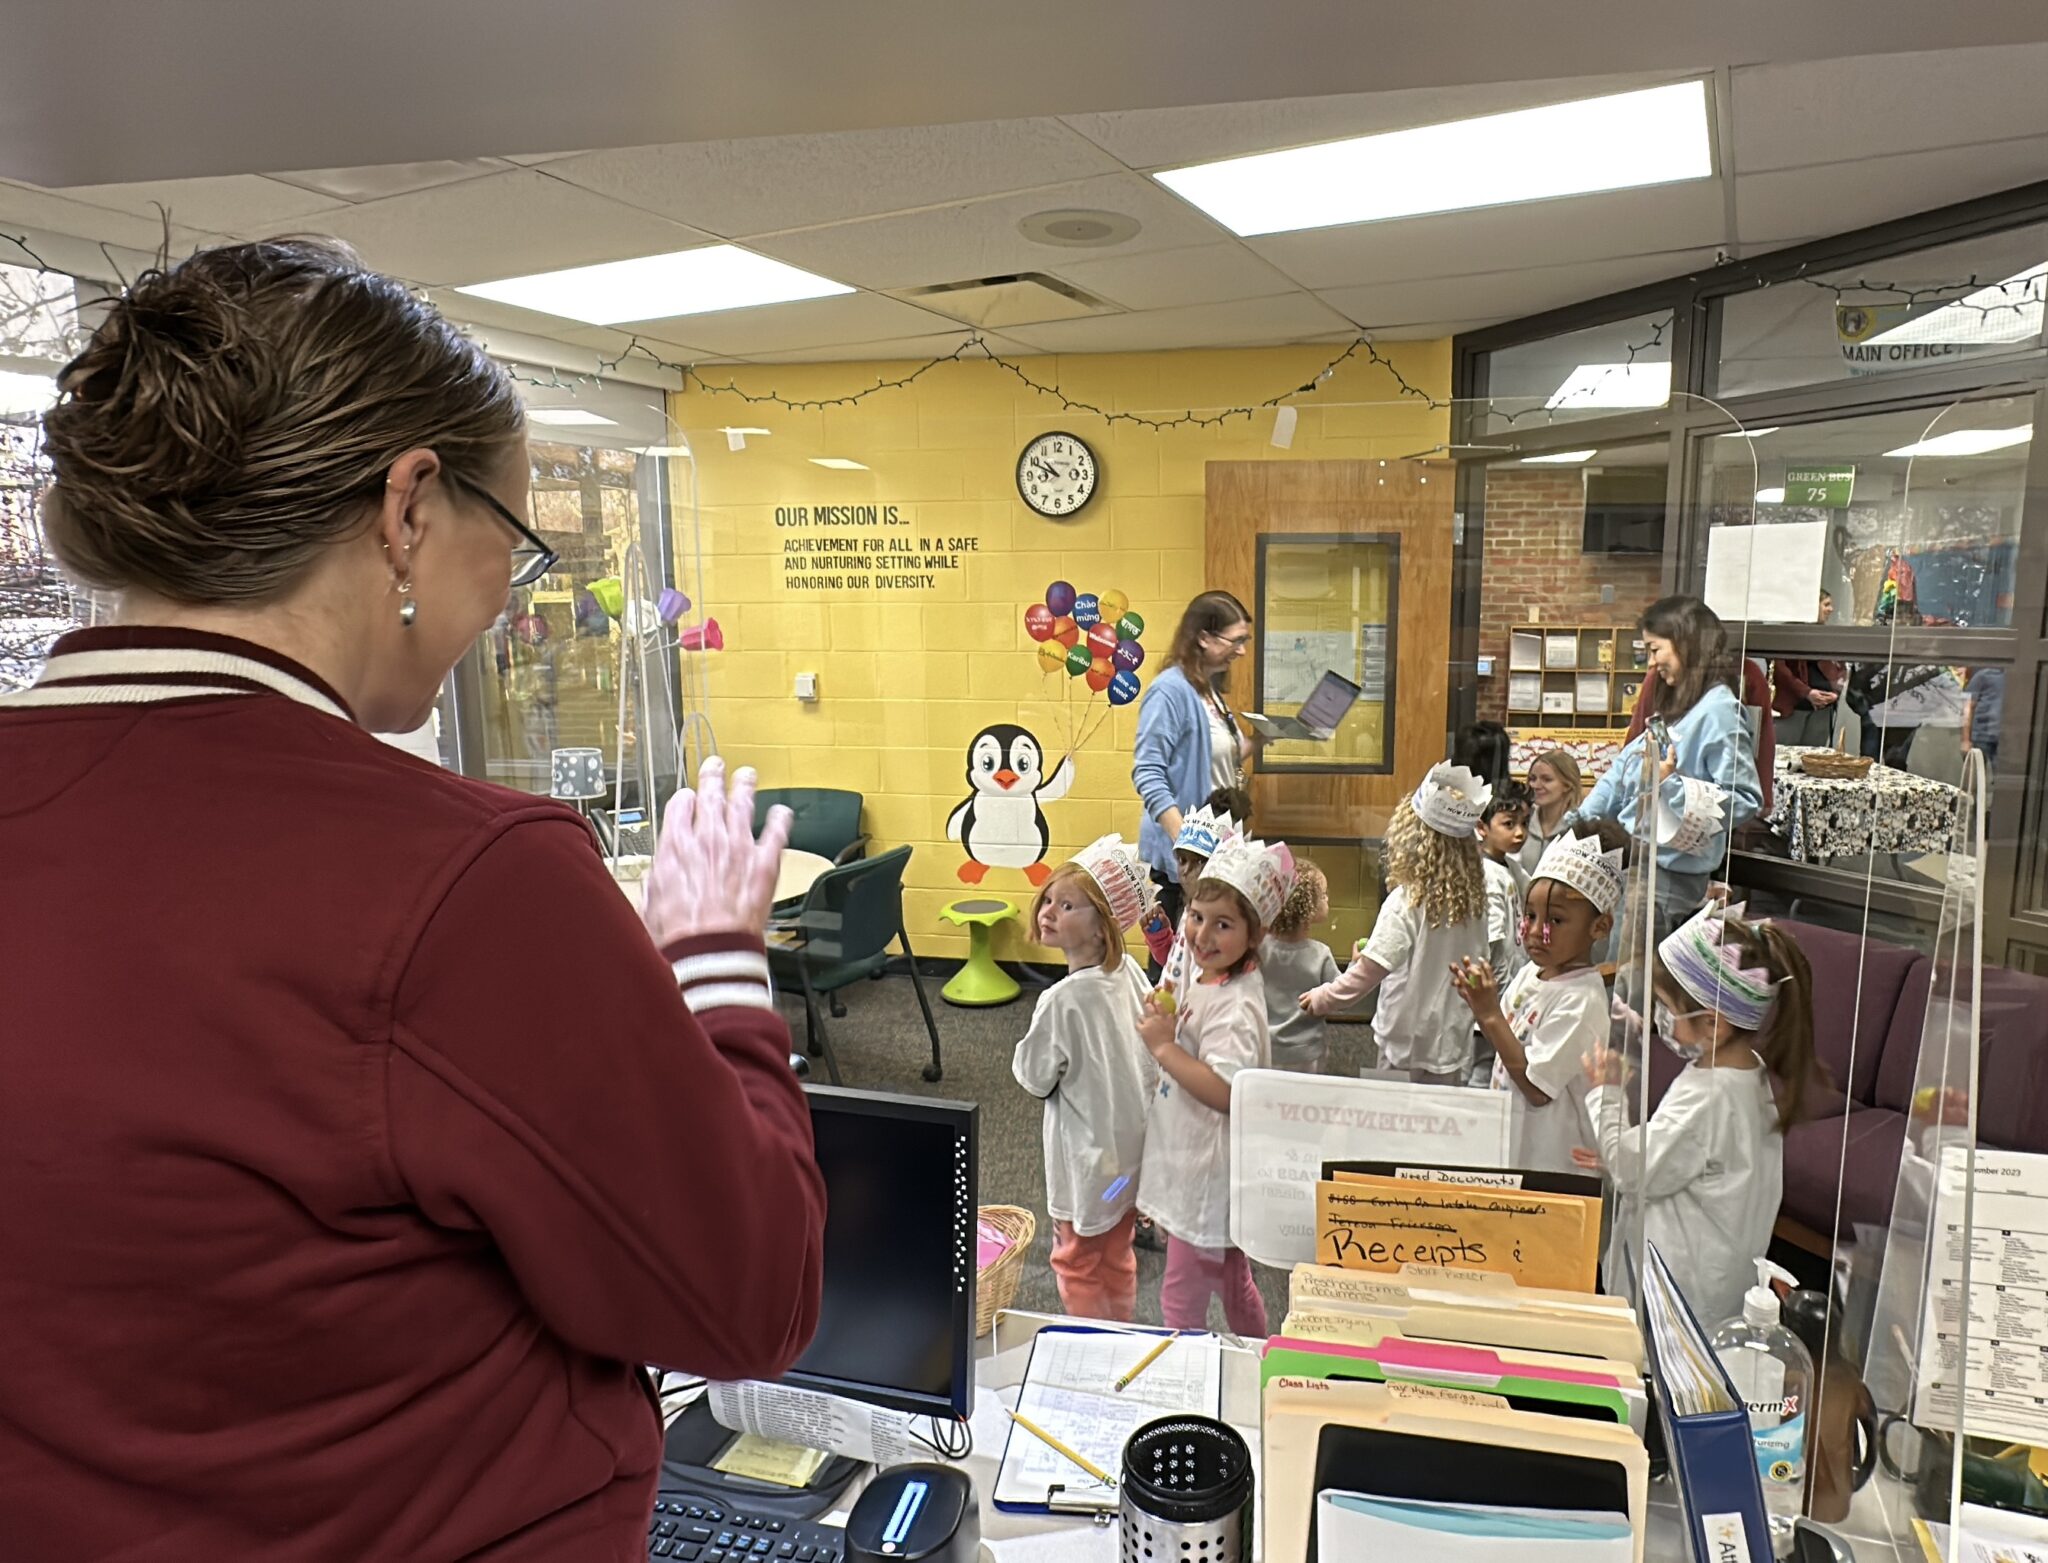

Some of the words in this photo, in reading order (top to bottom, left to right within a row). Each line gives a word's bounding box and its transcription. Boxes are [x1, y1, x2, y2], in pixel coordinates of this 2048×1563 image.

[1842, 345, 1882, 361] MAIN
[1889, 344, 1953, 360] OFFICE
[1041, 446, 1047, 456] 11
[1054, 442, 1062, 453] 12
[1070, 445, 1072, 455] 1
[1030, 457, 1039, 466] 10
[1078, 456, 1084, 466] 2
[1027, 471, 1033, 481] 9
[1082, 469, 1088, 480] 3
[1788, 472, 1826, 481] GREEN
[1031, 485, 1037, 495] 8
[1077, 484, 1084, 494] 4
[1068, 495, 1074, 504] 5
[1808, 487, 1827, 502] 75
[1042, 495, 1048, 505] 7
[1055, 499, 1061, 508] 6
[775, 507, 808, 527] OUR
[814, 505, 877, 525] MISSION
[883, 506, 909, 525] IS...
[784, 539, 858, 552] ACHIEVEMENT
[863, 539, 884, 552] FOR
[889, 538, 912, 552] ALL
[920, 538, 931, 551] IN
[936, 538, 944, 551] A
[948, 537, 978, 551] SAFE
[784, 557, 807, 570] AND
[811, 556, 872, 569] NURTURING
[876, 555, 921, 569] SETTING
[924, 555, 959, 569] WHILE
[786, 575, 843, 589] HONORING
[847, 575, 869, 589] OUR
[875, 575, 935, 589] DIVERSITY.
[1075, 600, 1096, 609] Chào
[1067, 651, 1091, 667] Karibu
[2001, 1167, 2022, 1177] 2023
[1401, 1170, 1430, 1182] Need
[1437, 1171, 1515, 1186] Documents
[1323, 1228, 1488, 1267] Receipts
[1278, 1377, 1304, 1389] Class
[1306, 1380, 1331, 1391] Lists
